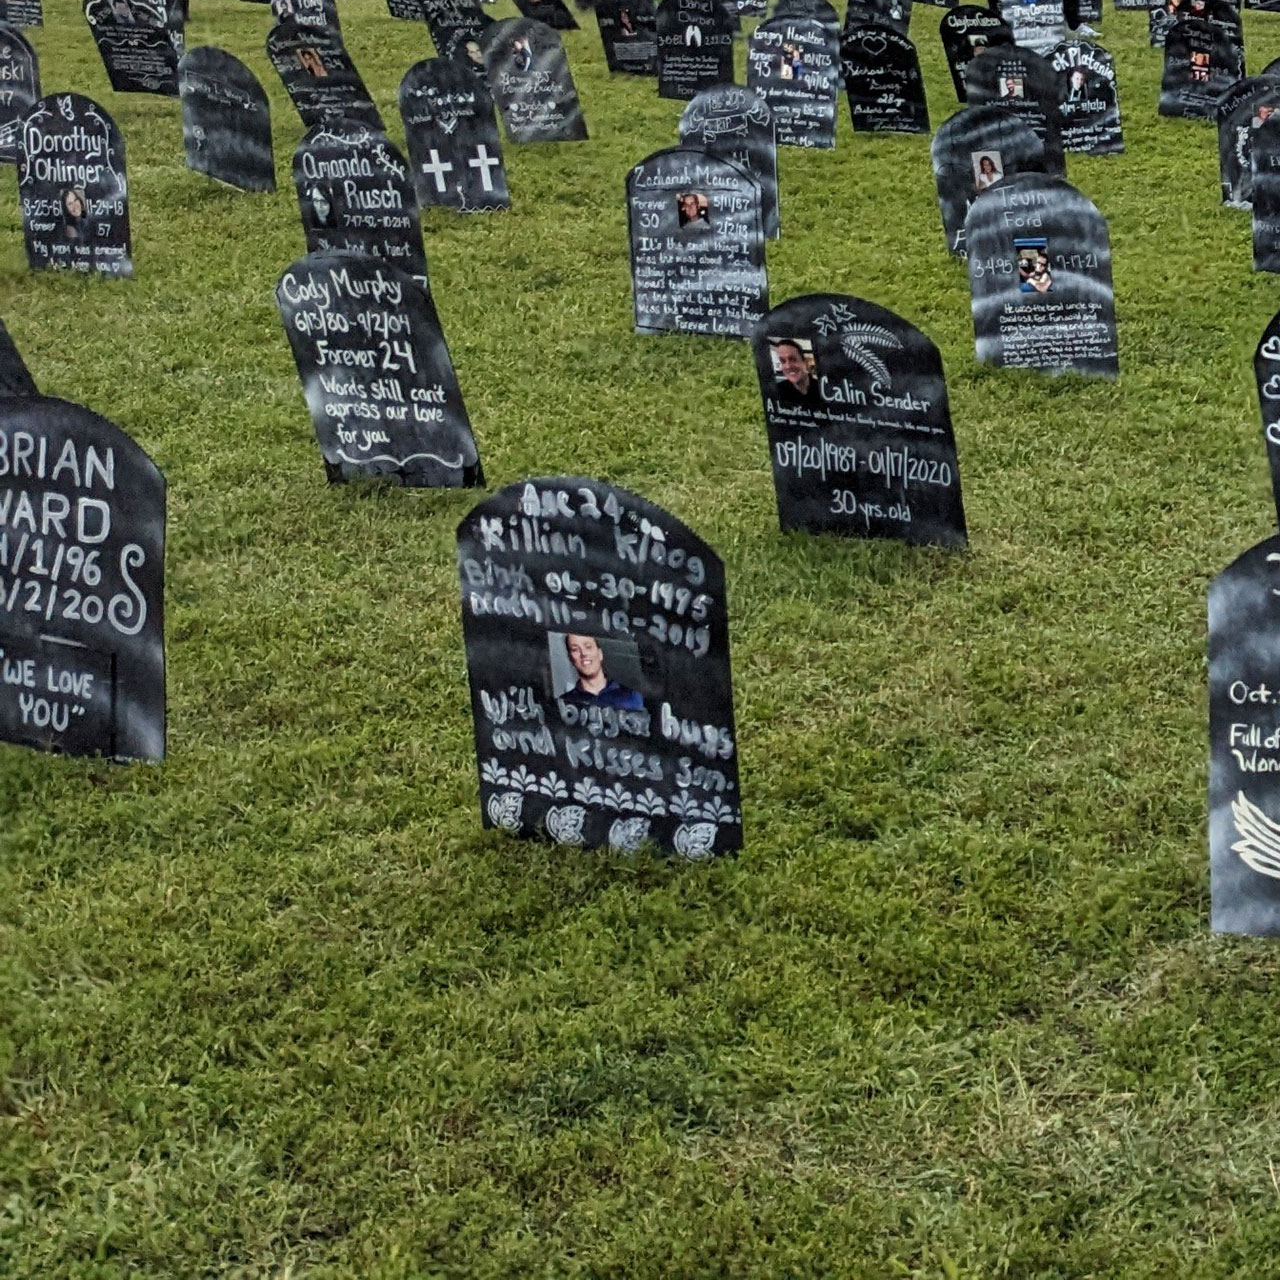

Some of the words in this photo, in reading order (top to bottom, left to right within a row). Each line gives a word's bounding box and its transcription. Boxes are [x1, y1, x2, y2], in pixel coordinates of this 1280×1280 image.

[29, 126, 102, 160] Dorothy
[35, 160, 103, 189] Ohlinger
[640, 214, 659, 229] 30
[1003, 211, 1043, 228] Ford
[282, 273, 330, 308] Cody
[330, 268, 402, 304] Murphy
[316, 340, 377, 368] Forever
[379, 341, 417, 373] 24
[319, 374, 367, 397] Words
[371, 379, 404, 403] still
[821, 376, 867, 406] Calin
[871, 384, 931, 413] Sender
[386, 406, 407, 420] our
[414, 404, 445, 422] love
[337, 424, 357, 444] for
[362, 429, 390, 450] you
[776, 435, 856, 481] 09/20/1989
[869, 446, 951, 489] 01/17/2020
[830, 490, 856, 514] 30
[479, 515, 586, 559] Killian
[47, 665, 94, 700] LOVE
[491, 727, 556, 757] and
[661, 702, 734, 759] hugs
